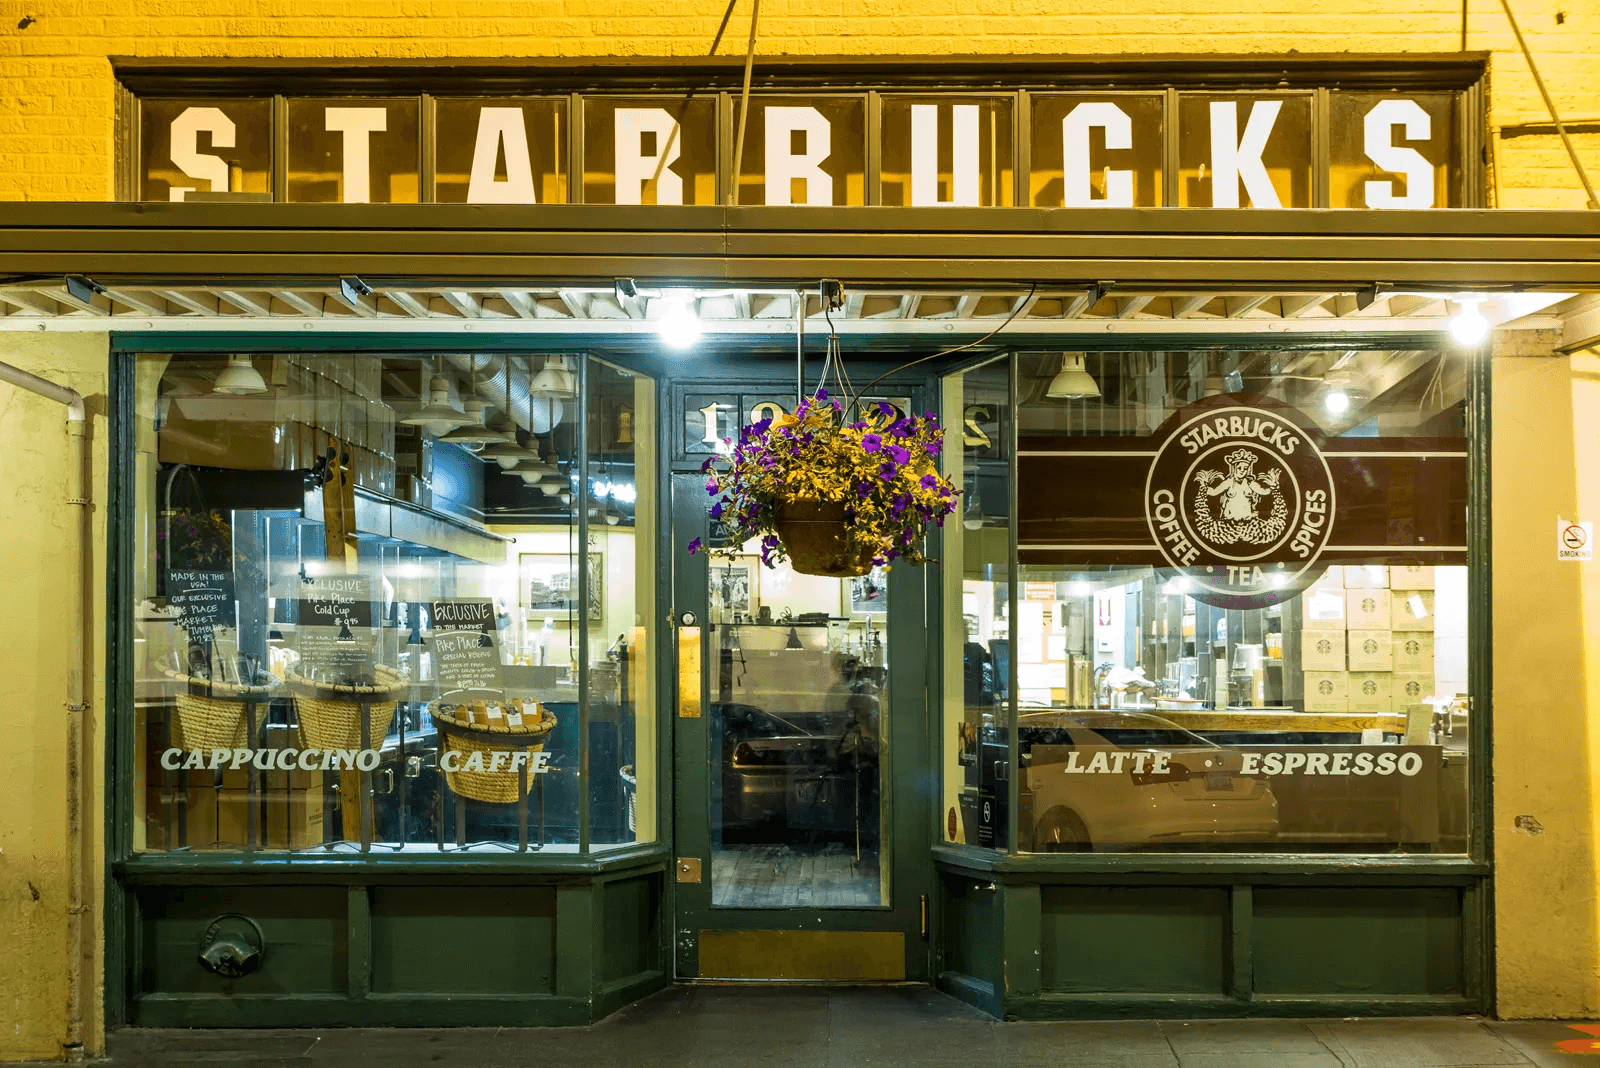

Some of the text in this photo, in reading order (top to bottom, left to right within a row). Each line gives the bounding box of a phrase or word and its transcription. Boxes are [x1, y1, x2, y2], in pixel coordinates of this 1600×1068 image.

[168, 99, 1434, 209] STARBUCKS
[1180, 416, 1300, 455] STARBUCKS
[1153, 489, 1327, 586] COFFEE TEA SPICES
[170, 572, 196, 581] MADE
[301, 579, 364, 592] EXCLUSIVE
[172, 594, 228, 603] OUR EXCLUSIVE
[307, 592, 356, 604] Pike Place
[190, 604, 218, 614] PLACE
[314, 604, 350, 618] Cold Cup
[176, 615, 216, 626] MARKET
[442, 651, 492, 660] SPECIAL RESERVE
[160, 747, 552, 773] CAPPUCCINO CAFFE
[1064, 751, 1423, 776] LATTE ESPRESSO
